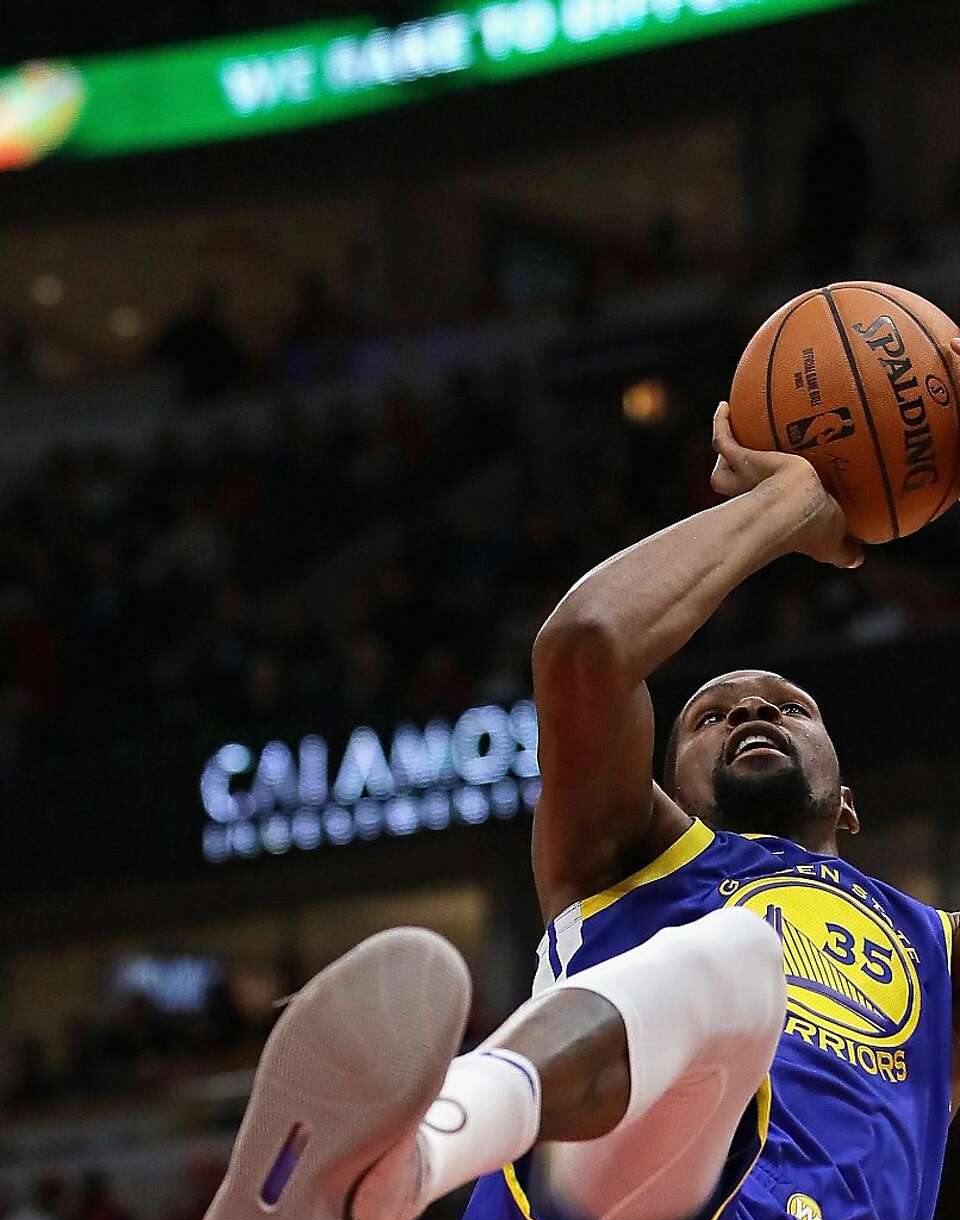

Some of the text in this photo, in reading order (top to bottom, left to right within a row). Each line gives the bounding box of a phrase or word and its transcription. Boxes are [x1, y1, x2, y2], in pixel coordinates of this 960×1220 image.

[852, 313, 939, 493] SPALDING
[822, 921, 894, 985] 35
[783, 1013, 908, 1083] RRIORS
